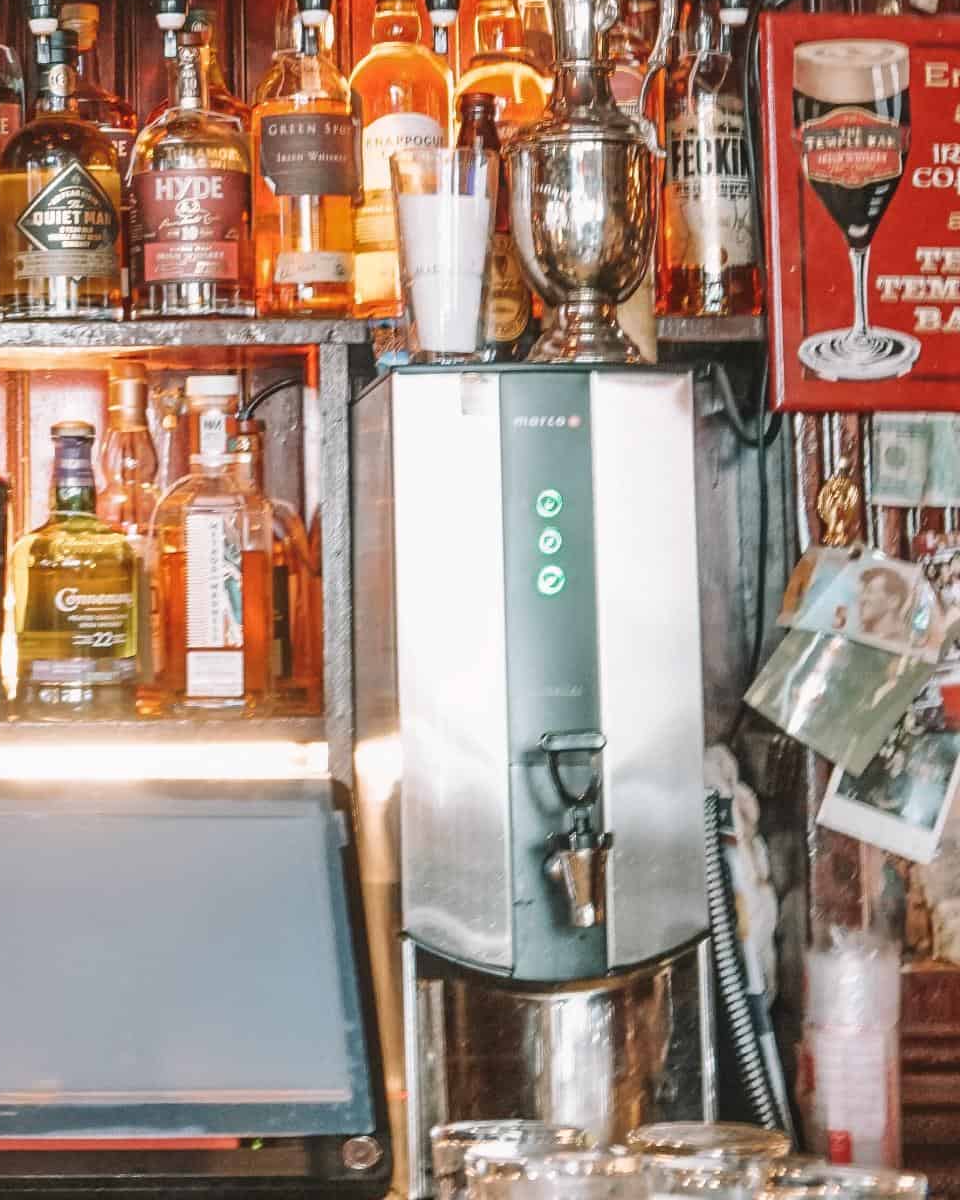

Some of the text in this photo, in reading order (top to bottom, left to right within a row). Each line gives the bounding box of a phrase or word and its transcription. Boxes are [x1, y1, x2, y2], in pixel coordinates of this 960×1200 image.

[268, 123, 317, 136] GREEN
[155, 176, 225, 201] HYDE
[912, 167, 960, 195] CO
[32, 210, 81, 225] QUIET
